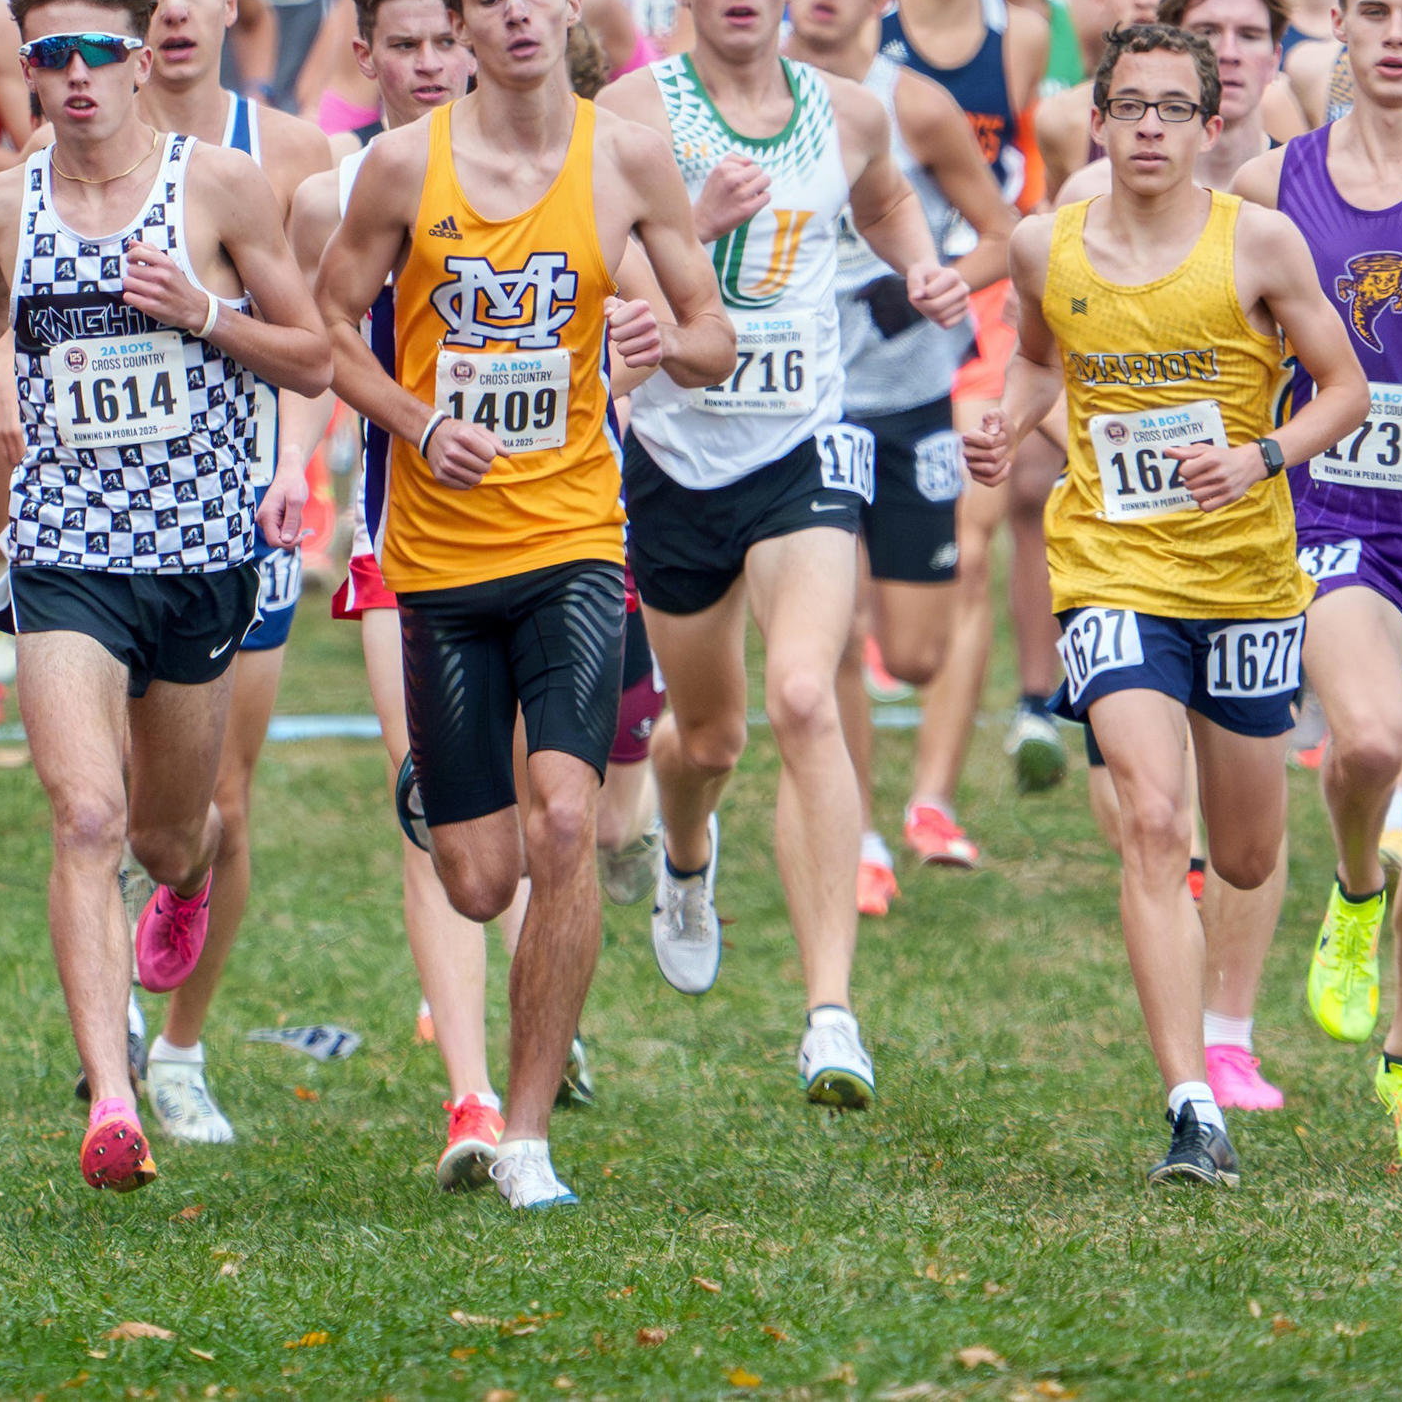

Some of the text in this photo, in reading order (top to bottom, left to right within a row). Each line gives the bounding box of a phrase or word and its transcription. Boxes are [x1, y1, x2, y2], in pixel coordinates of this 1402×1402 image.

[429, 228, 463, 240] adidas
[28, 303, 175, 345] KNIGHT
[100, 342, 154, 357] 2A BOYS
[92, 353, 166, 372] CROSS COUNTRY
[491, 360, 543, 372] 2A BOYS
[705, 350, 804, 393] 716
[1070, 349, 1219, 387] MARION
[479, 371, 553, 386] CROSS COUNTRY
[68, 371, 178, 426] 1614
[1372, 392, 1381, 402] A
[448, 388, 558, 433] 1409
[1140, 412, 1190, 429] 2A BOYS
[74, 431, 103, 441] RUNNING
[104, 430, 112, 439] IN
[112, 427, 138, 438] PEORIA
[139, 425, 158, 437] 2025
[515, 437, 534, 447] 2025
[1133, 429, 1161, 443] CROSS
[1162, 422, 1205, 439] COUNTRY
[1111, 438, 1214, 496] 162
[1301, 545, 1347, 575] 37
[1063, 609, 1126, 697] 1627
[1214, 627, 1299, 691] 1627
